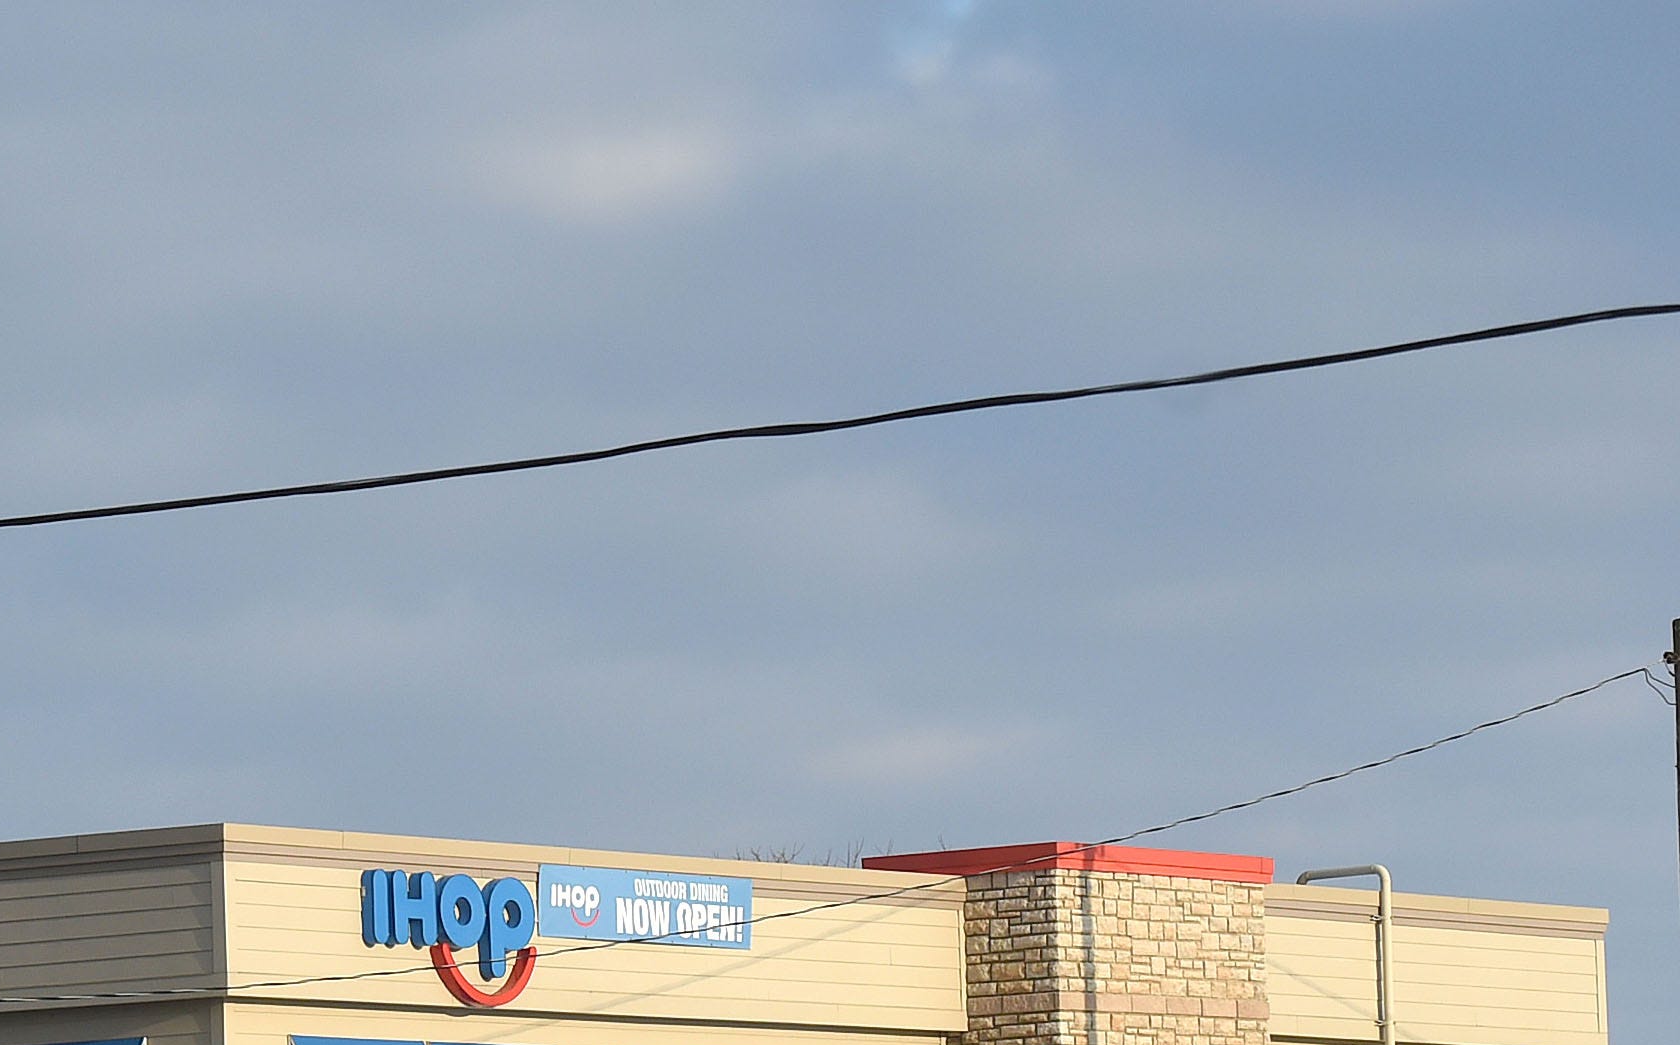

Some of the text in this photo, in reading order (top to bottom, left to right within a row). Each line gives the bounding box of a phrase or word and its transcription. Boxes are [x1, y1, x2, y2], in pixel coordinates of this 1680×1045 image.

[633, 878, 729, 903] OUTDOOR DINING
[615, 897, 745, 943] NOW OPEN!
